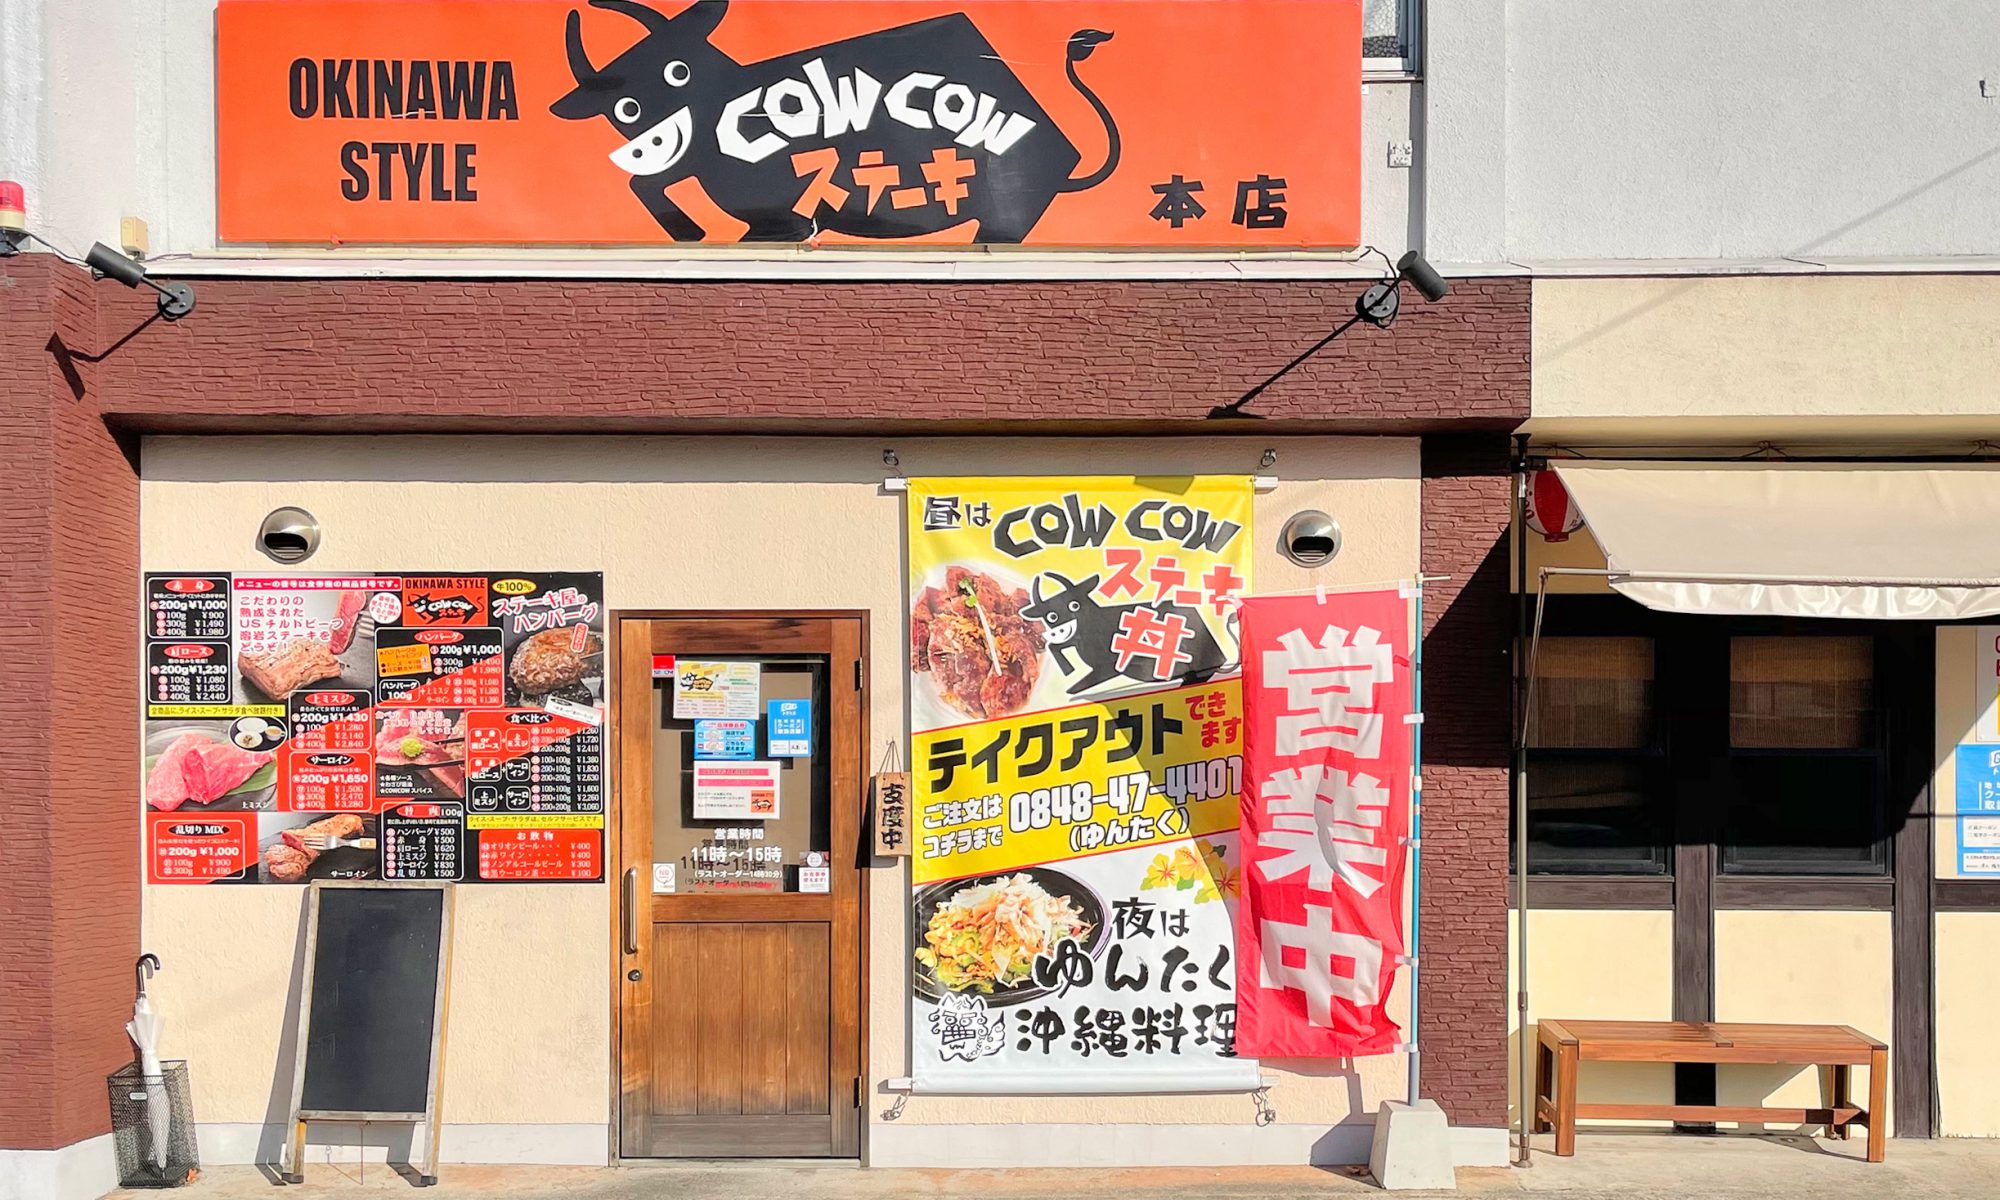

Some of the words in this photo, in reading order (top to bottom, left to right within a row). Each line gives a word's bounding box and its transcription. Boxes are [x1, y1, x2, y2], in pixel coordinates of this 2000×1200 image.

[288, 57, 519, 121] OKINAWA
[341, 141, 478, 202] STYLE
[790, 146, 976, 219] ステーキ
[923, 496, 992, 531] 昼は
[405, 579, 453, 590] OKINAWA
[457, 579, 486, 590] STYLE
[1098, 548, 1243, 616] ステーキ
[159, 600, 188, 611] 200g
[188, 600, 227, 611] ¥1,000
[241, 596, 304, 606] こだわりの
[492, 587, 588, 618] ステーキ屋の
[167, 611, 187, 621] 100g
[202, 611, 225, 619] ¥900
[240, 607, 304, 617] 熟成された
[513, 602, 599, 633] ハンバーグ
[166, 620, 187, 629] 300g
[194, 620, 225, 628] ¥1,490
[166, 628, 187, 637] 400g
[240, 631, 330, 641] 溶岩ステーキを
[416, 632, 461, 641] ハンバーグ
[1111, 608, 1196, 681] 丼
[440, 646, 462, 656] 200g
[463, 645, 502, 655] ¥1,000
[443, 658, 463, 667] 300g
[160, 665, 189, 676] 200g
[188, 665, 227, 675] ¥1,230
[443, 667, 463, 675] 400g
[170, 676, 190, 685] 100g
[170, 685, 190, 694] 300g
[382, 682, 417, 690] ハンバーグ
[170, 693, 190, 702] 400g
[387, 691, 412, 700] 100g
[1185, 692, 1227, 720] でき
[301, 714, 329, 723] 200g
[330, 713, 368, 722] ¥1,430
[511, 714, 550, 723] 食べ比べ
[306, 724, 326, 732] 100g
[1200, 716, 1243, 749] ます
[306, 732, 326, 741] 300g
[306, 741, 326, 749] 400g
[928, 703, 1184, 795] テイクアウト
[311, 756, 352, 764] サーロイン
[301, 774, 329, 785] 200g
[331, 774, 368, 783] ¥1,650
[306, 785, 326, 793] 100g
[1009, 755, 1243, 833] 0848-47-4401
[306, 793, 326, 801] 300g
[306, 801, 326, 809] 400g
[441, 809, 461, 817] 100g
[922, 794, 1004, 830] ご注文は
[176, 825, 202, 834] 乱切り
[205, 826, 224, 834] MIX
[1254, 623, 1395, 1030] 営業中
[397, 828, 433, 836] ハンバーグ
[434, 828, 455, 836] ¥500
[714, 828, 764, 840] 営業時間
[434, 836, 455, 844] ¥500
[922, 824, 1004, 860] コチラまで
[168, 847, 197, 857] 200g
[200, 847, 240, 856] ¥1,000
[174, 859, 194, 867] 100g
[173, 867, 194, 876] 300g
[330, 870, 369, 878] サーロイン
[397, 869, 426, 877] 乱切り
[434, 869, 455, 877] ¥500
[1111, 896, 1190, 941] 夜は
[1033, 938, 1232, 1000] ゆんたく
[1014, 1001, 1238, 1058] 沖縄料理
